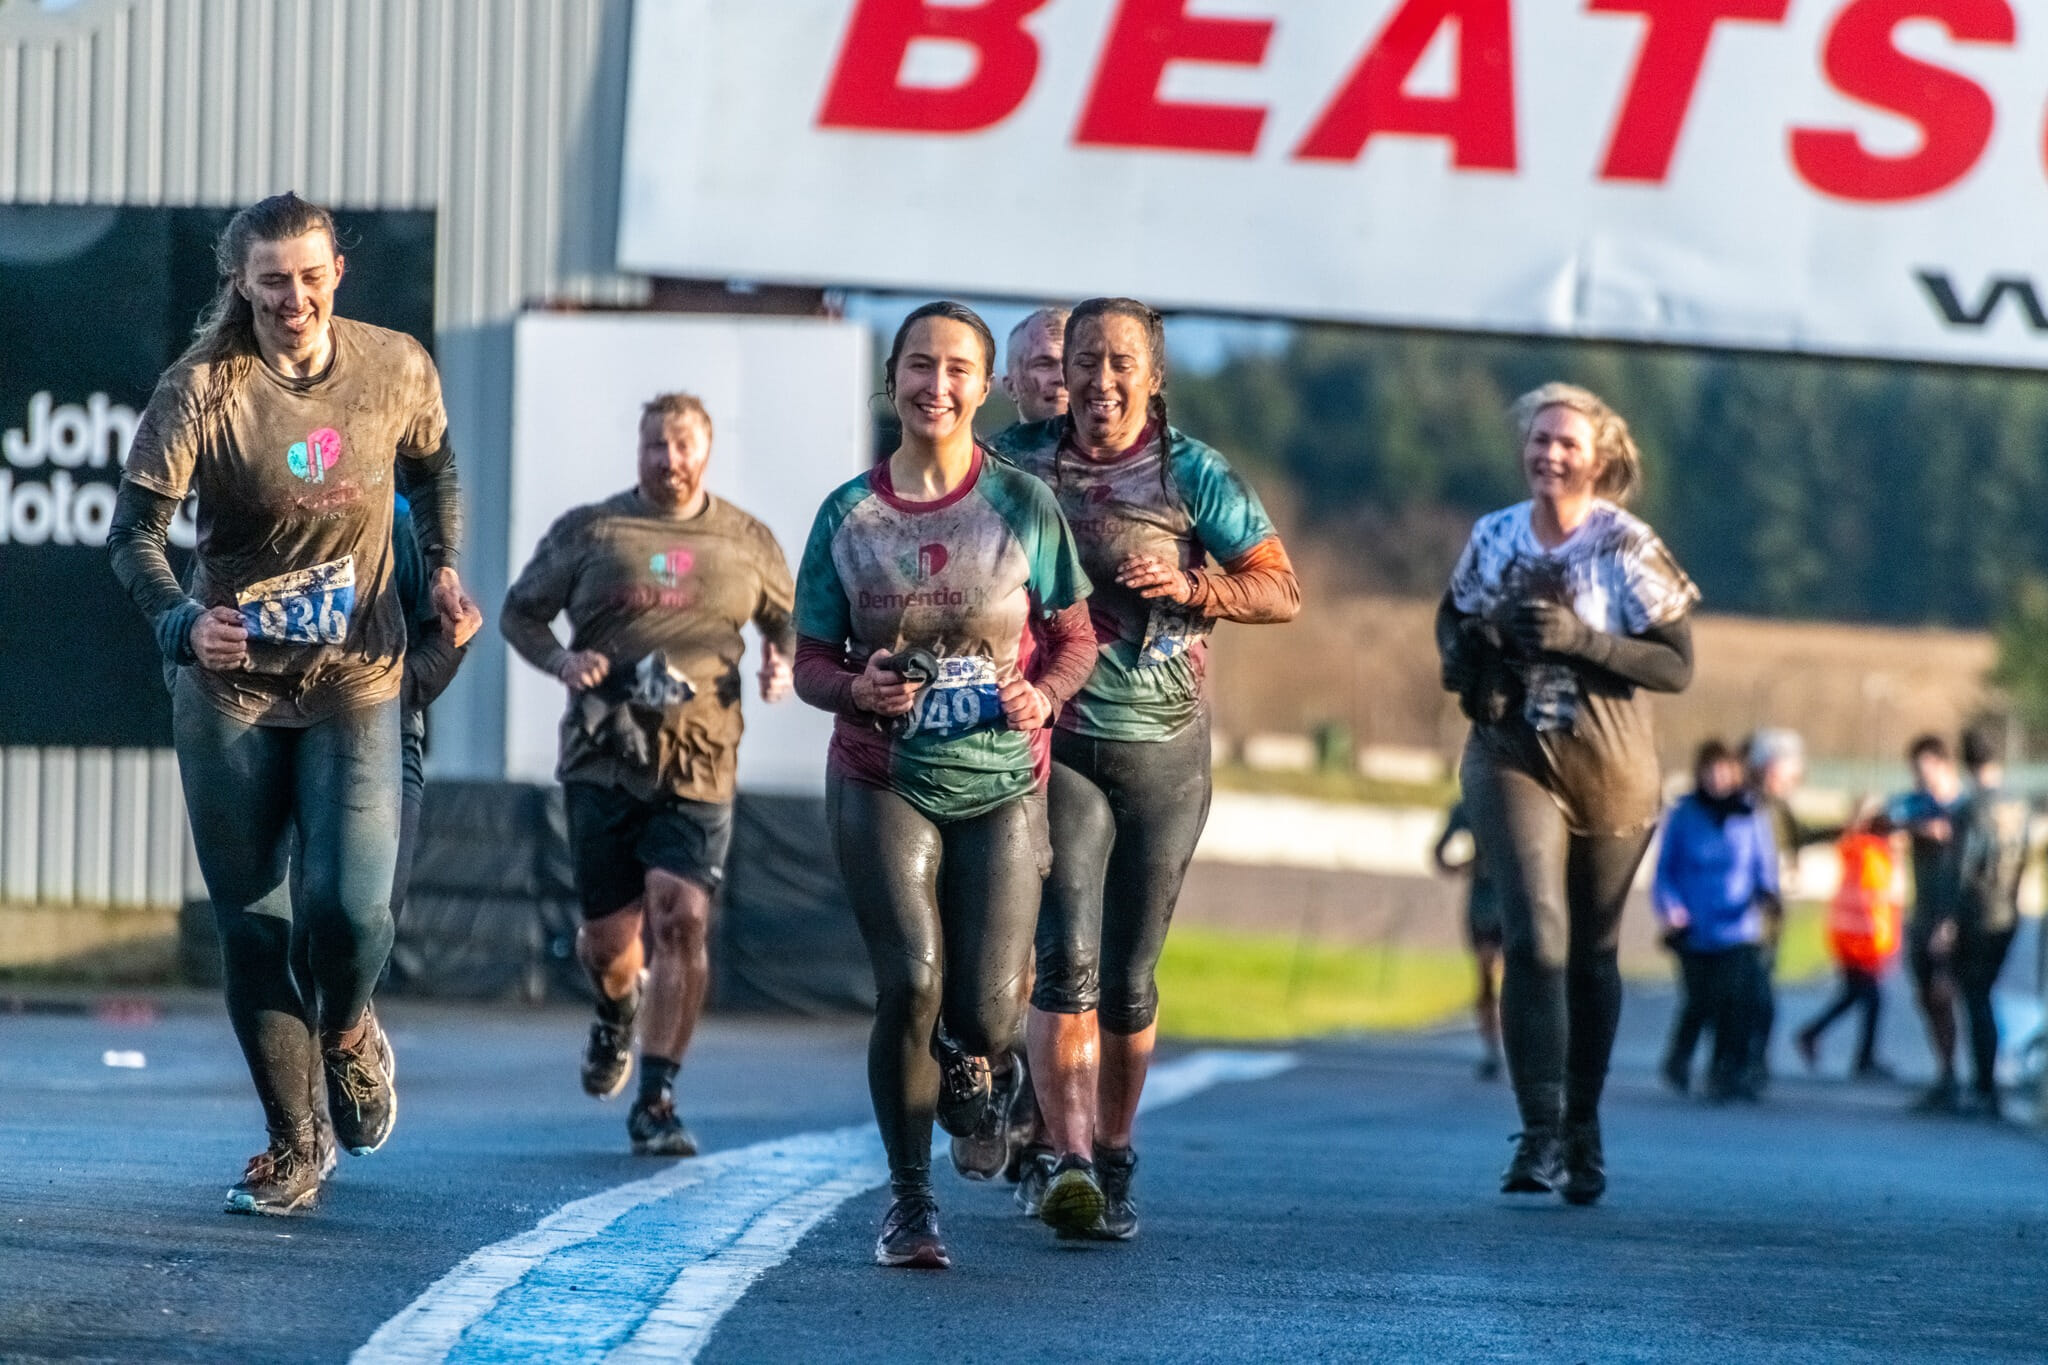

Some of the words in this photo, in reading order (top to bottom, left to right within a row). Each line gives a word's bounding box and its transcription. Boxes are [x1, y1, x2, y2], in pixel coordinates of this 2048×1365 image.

[814, 0, 2048, 206] BEATS
[2, 389, 147, 469] Joh
[858, 586, 963, 609] Dementia
